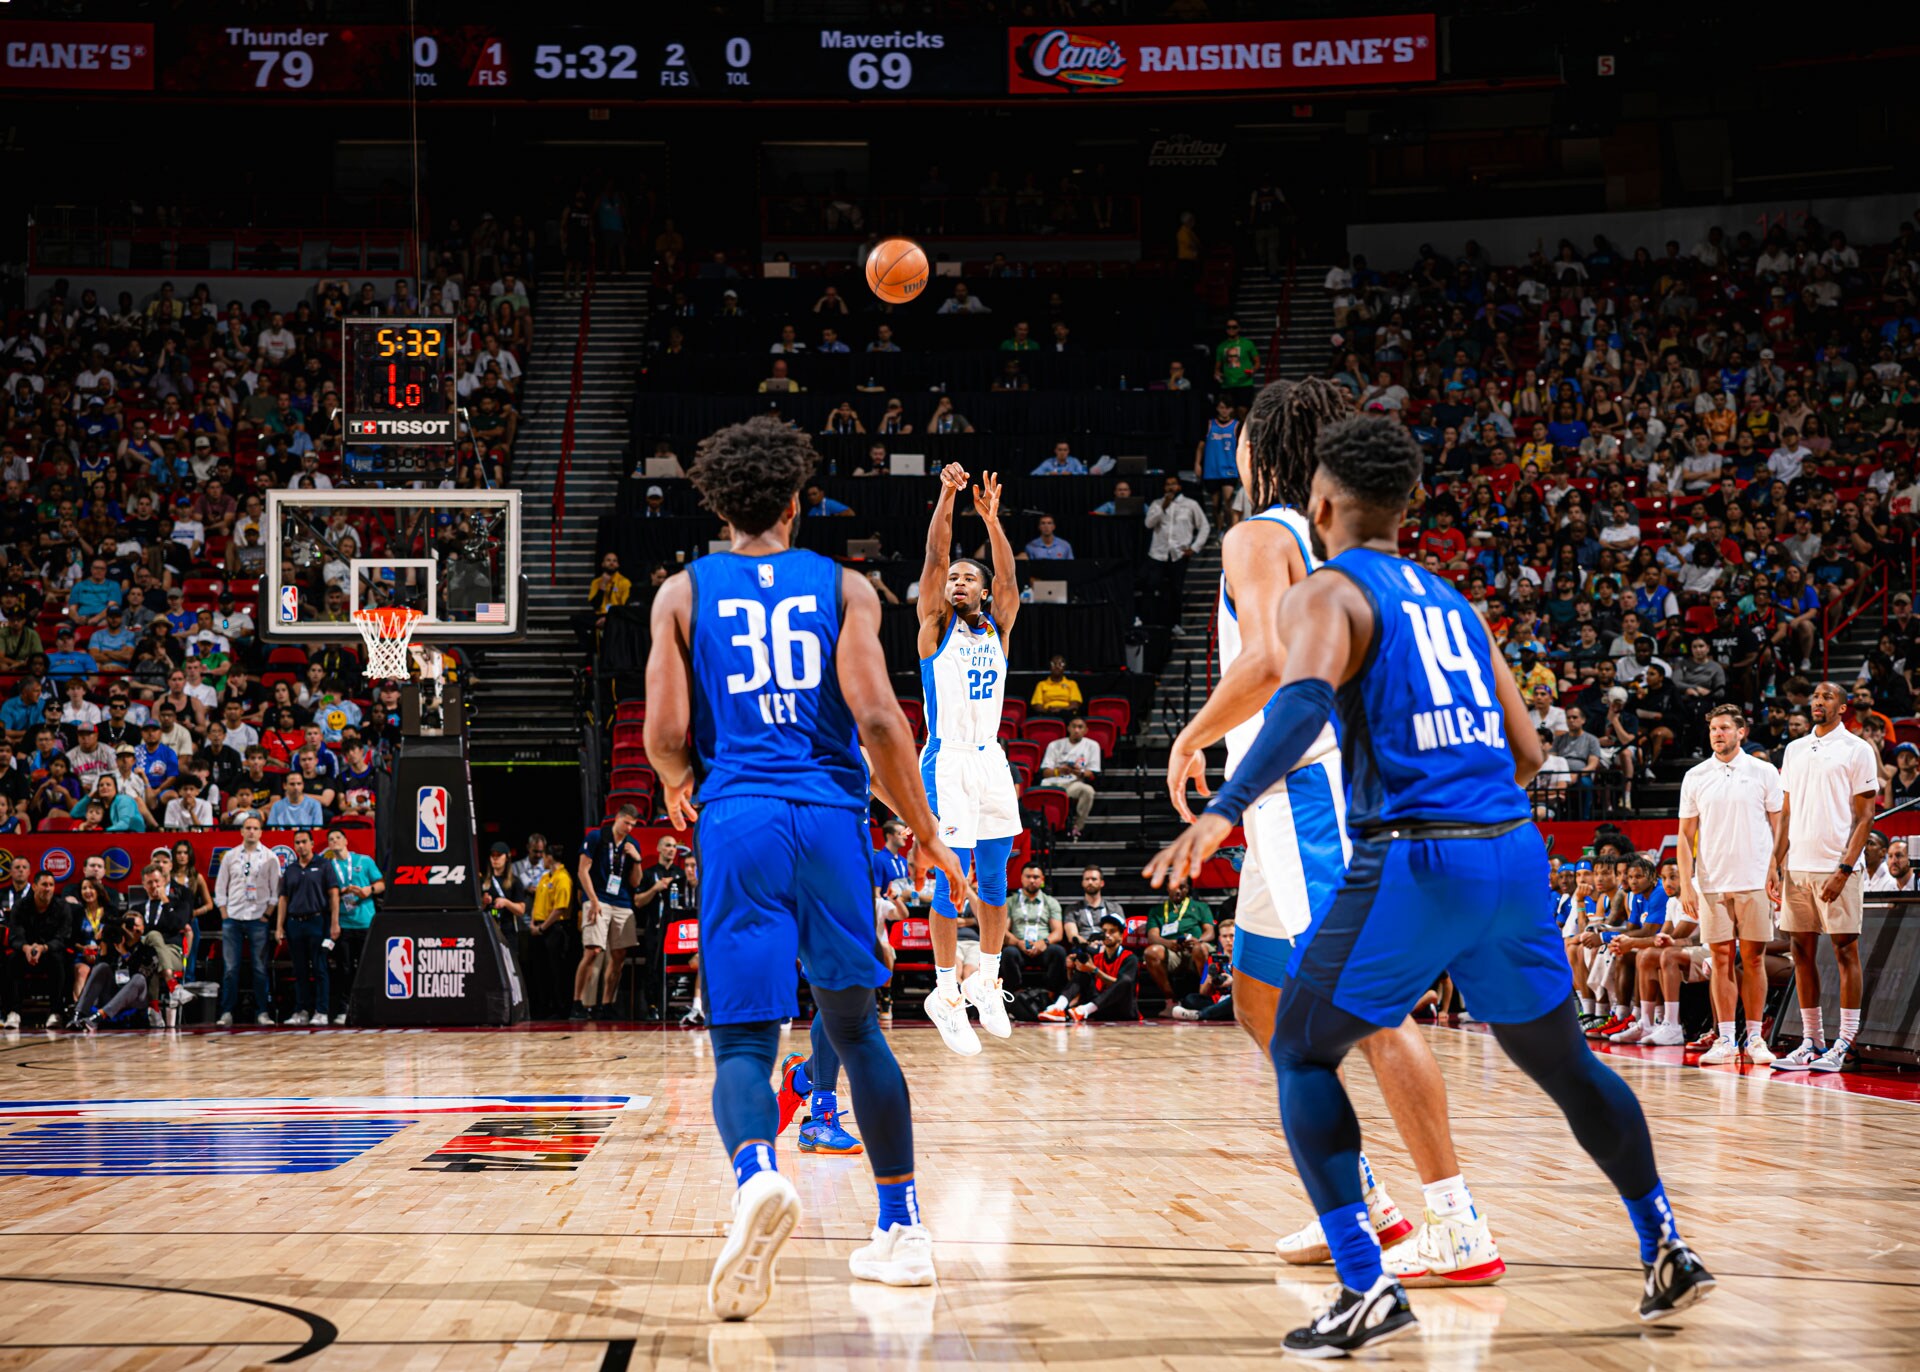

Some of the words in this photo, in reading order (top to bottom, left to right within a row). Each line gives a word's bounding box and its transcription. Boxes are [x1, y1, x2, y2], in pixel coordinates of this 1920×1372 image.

[226, 28, 329, 47] Thunder
[821, 30, 944, 49] Mavericks
[413, 36, 438, 67] 0
[487, 43, 502, 66] 1
[534, 44, 638, 79] 5:32
[665, 43, 685, 66] 2
[726, 37, 751, 68] 0
[1033, 29, 1127, 77] Cane's
[1139, 43, 1282, 72] RAISING
[249, 50, 314, 89] 79
[414, 73, 437, 87] TOL
[479, 70, 507, 86] FLS
[661, 70, 689, 86] FLS
[726, 72, 750, 85] TOL
[848, 52, 912, 90] 69
[1151, 139, 1227, 158] Findlay
[377, 328, 442, 357] 5:32
[377, 420, 450, 434] TISSOT
[718, 595, 822, 694] 36
[1401, 600, 1493, 708] 14
[971, 656, 994, 667] CITY
[967, 669, 998, 700] 22
[758, 692, 798, 724] KEY
[421, 836, 435, 848] NBA
[394, 865, 466, 885] 2K24
[417, 949, 475, 974] SUMMER
[417, 973, 465, 998] LEAGUE
